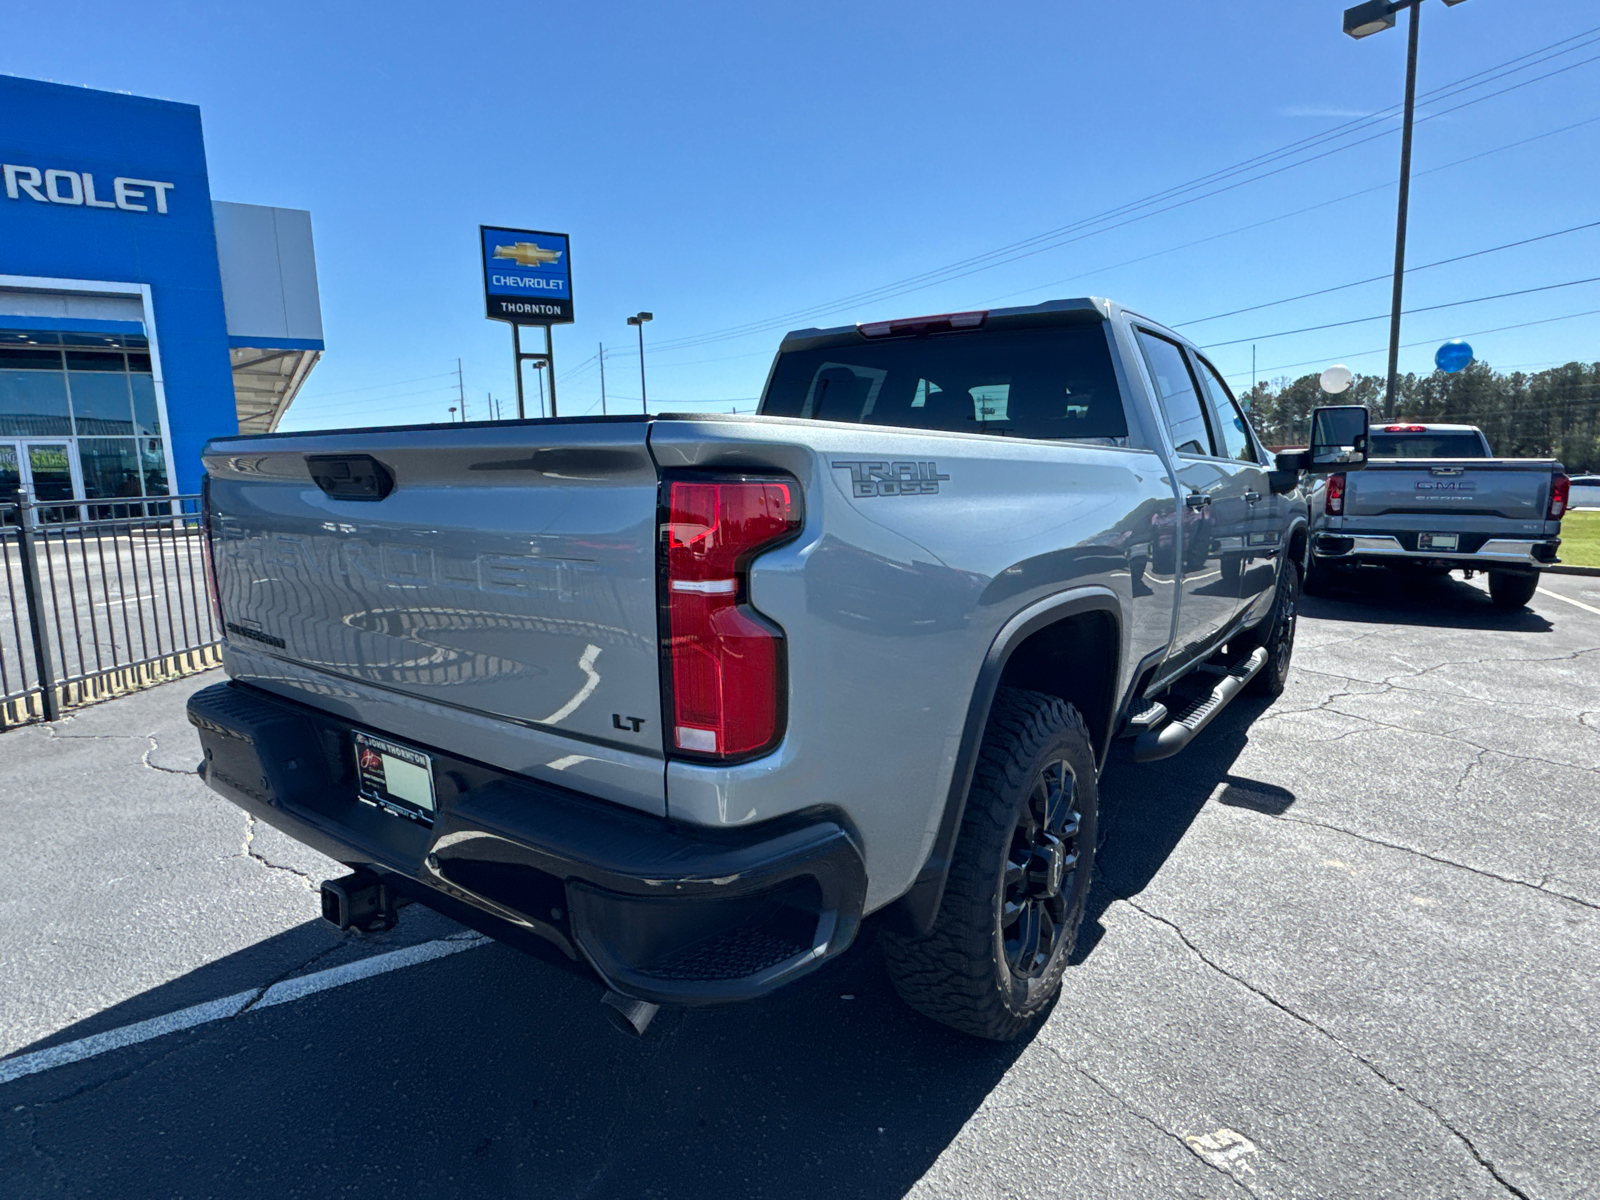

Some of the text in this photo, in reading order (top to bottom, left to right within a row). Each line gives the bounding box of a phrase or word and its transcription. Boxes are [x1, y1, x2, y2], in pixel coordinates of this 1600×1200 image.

[0, 163, 175, 214] ROLET
[492, 275, 565, 290] CHEVROLET
[500, 302, 562, 315] THORNTON
[831, 461, 950, 481] TRAIL
[853, 480, 940, 499] BOSS
[1415, 481, 1477, 491] GMC
[612, 713, 645, 733] LT
[368, 738, 387, 752] JOHN
